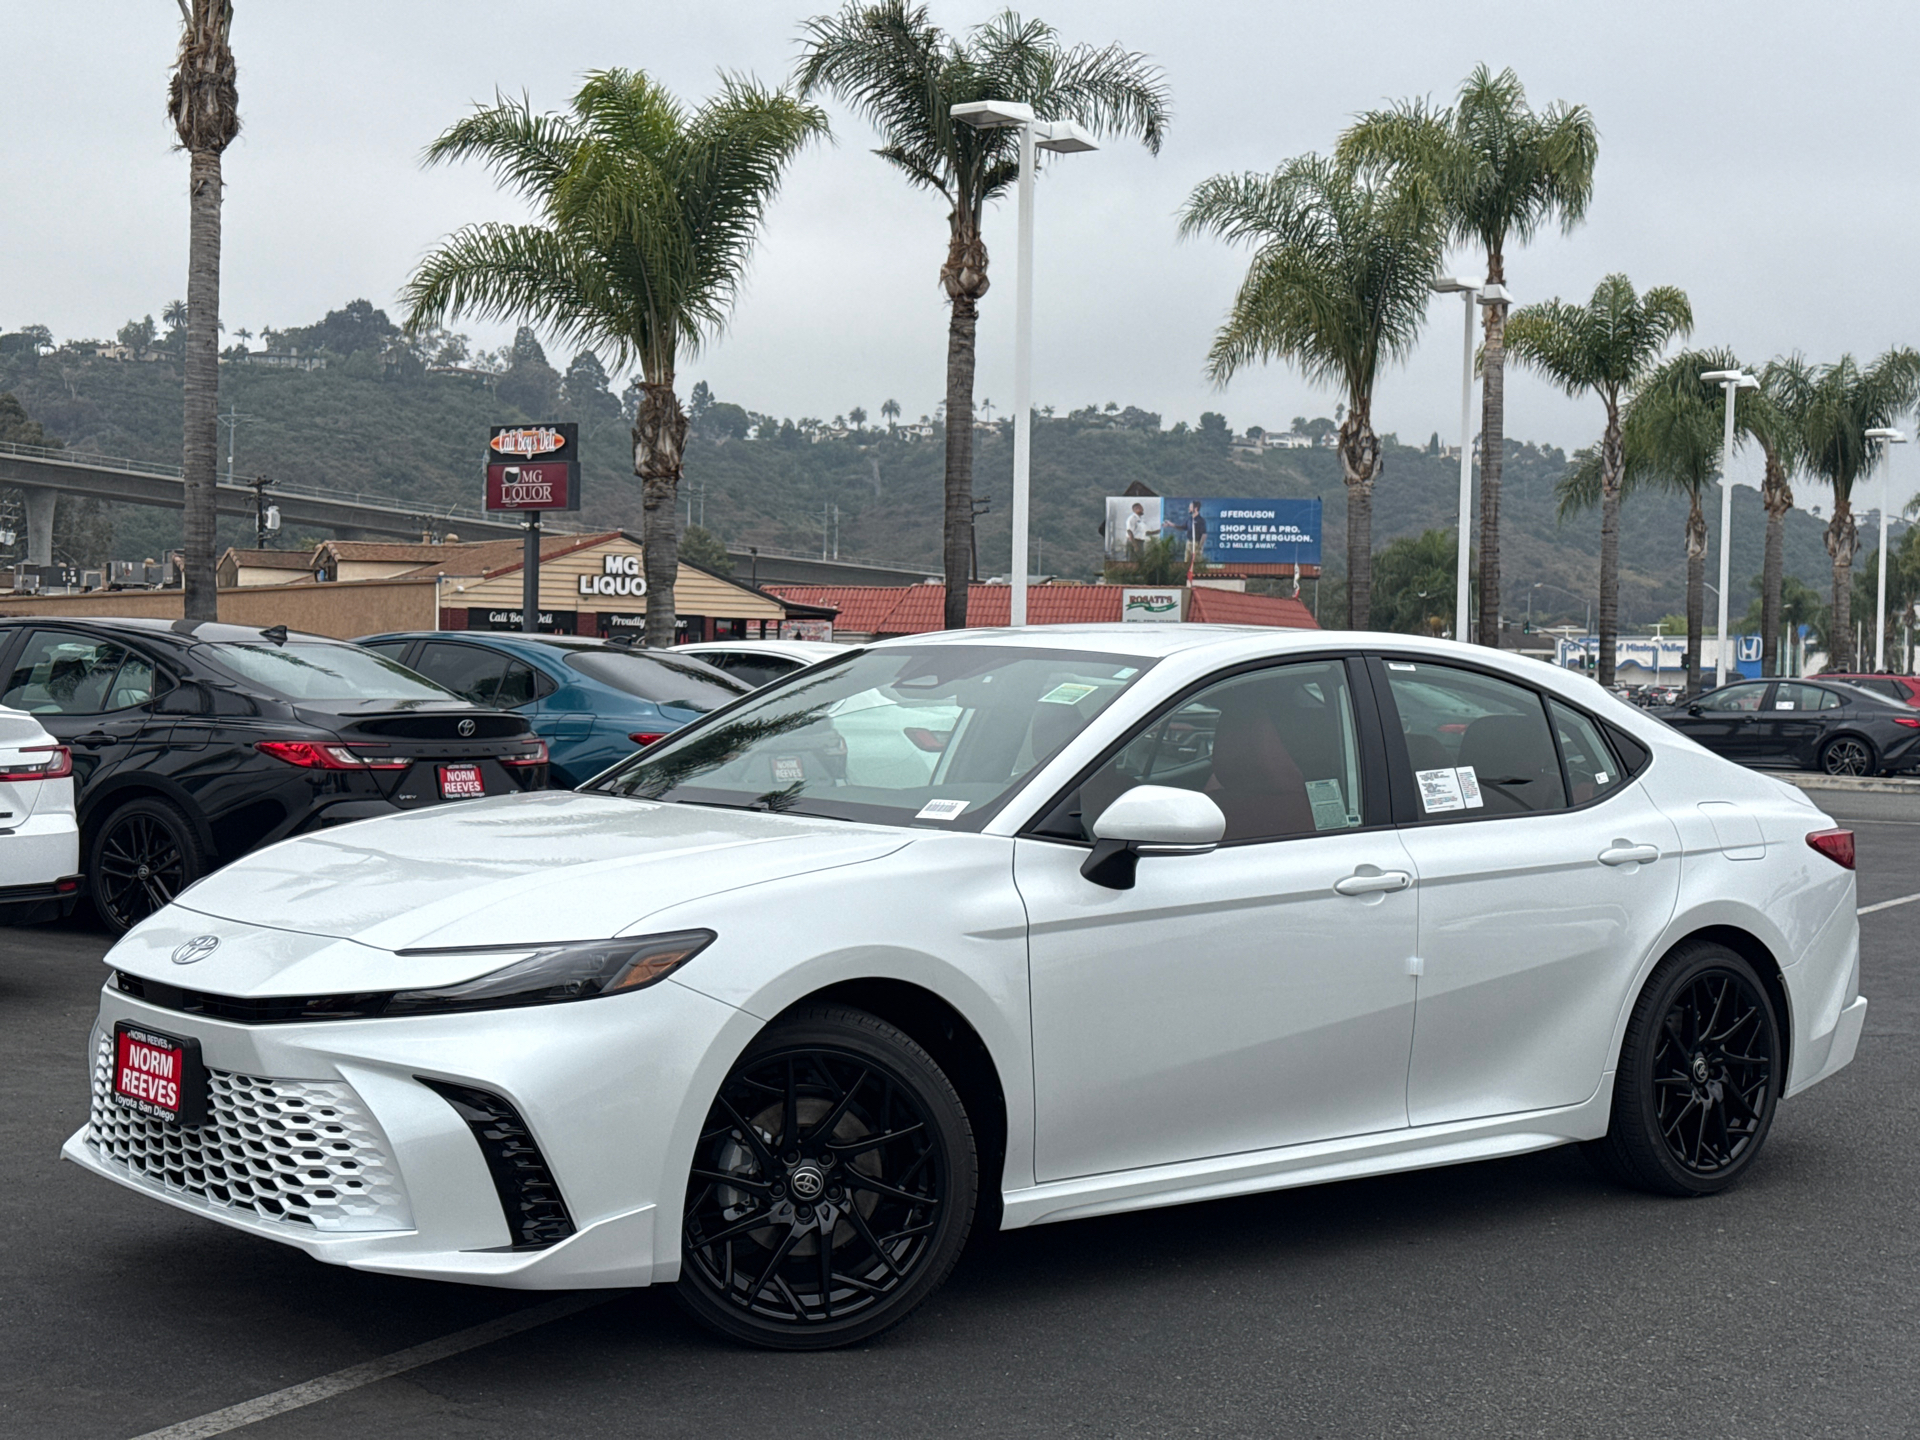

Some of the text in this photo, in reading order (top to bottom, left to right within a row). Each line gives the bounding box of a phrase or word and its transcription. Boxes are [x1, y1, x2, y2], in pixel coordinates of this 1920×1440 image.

[500, 428, 516, 454] Cali
[539, 427, 556, 452] Deli
[522, 470, 543, 483] MG
[1279, 525, 1301, 533] PRO.
[1260, 534, 1313, 543] FERGUSON.
[605, 555, 639, 575] MG
[580, 576, 647, 597] LIQUO
[489, 611, 508, 622] Cali
[1660, 643, 1686, 652] Valley
[447, 770, 476, 782] NORM
[444, 781, 481, 793] REEVES
[130, 1030, 168, 1049] NORM REEVES
[129, 1044, 174, 1079] NORM
[121, 1067, 177, 1107] REEVES
[114, 1091, 175, 1122] Toyota San Diego
